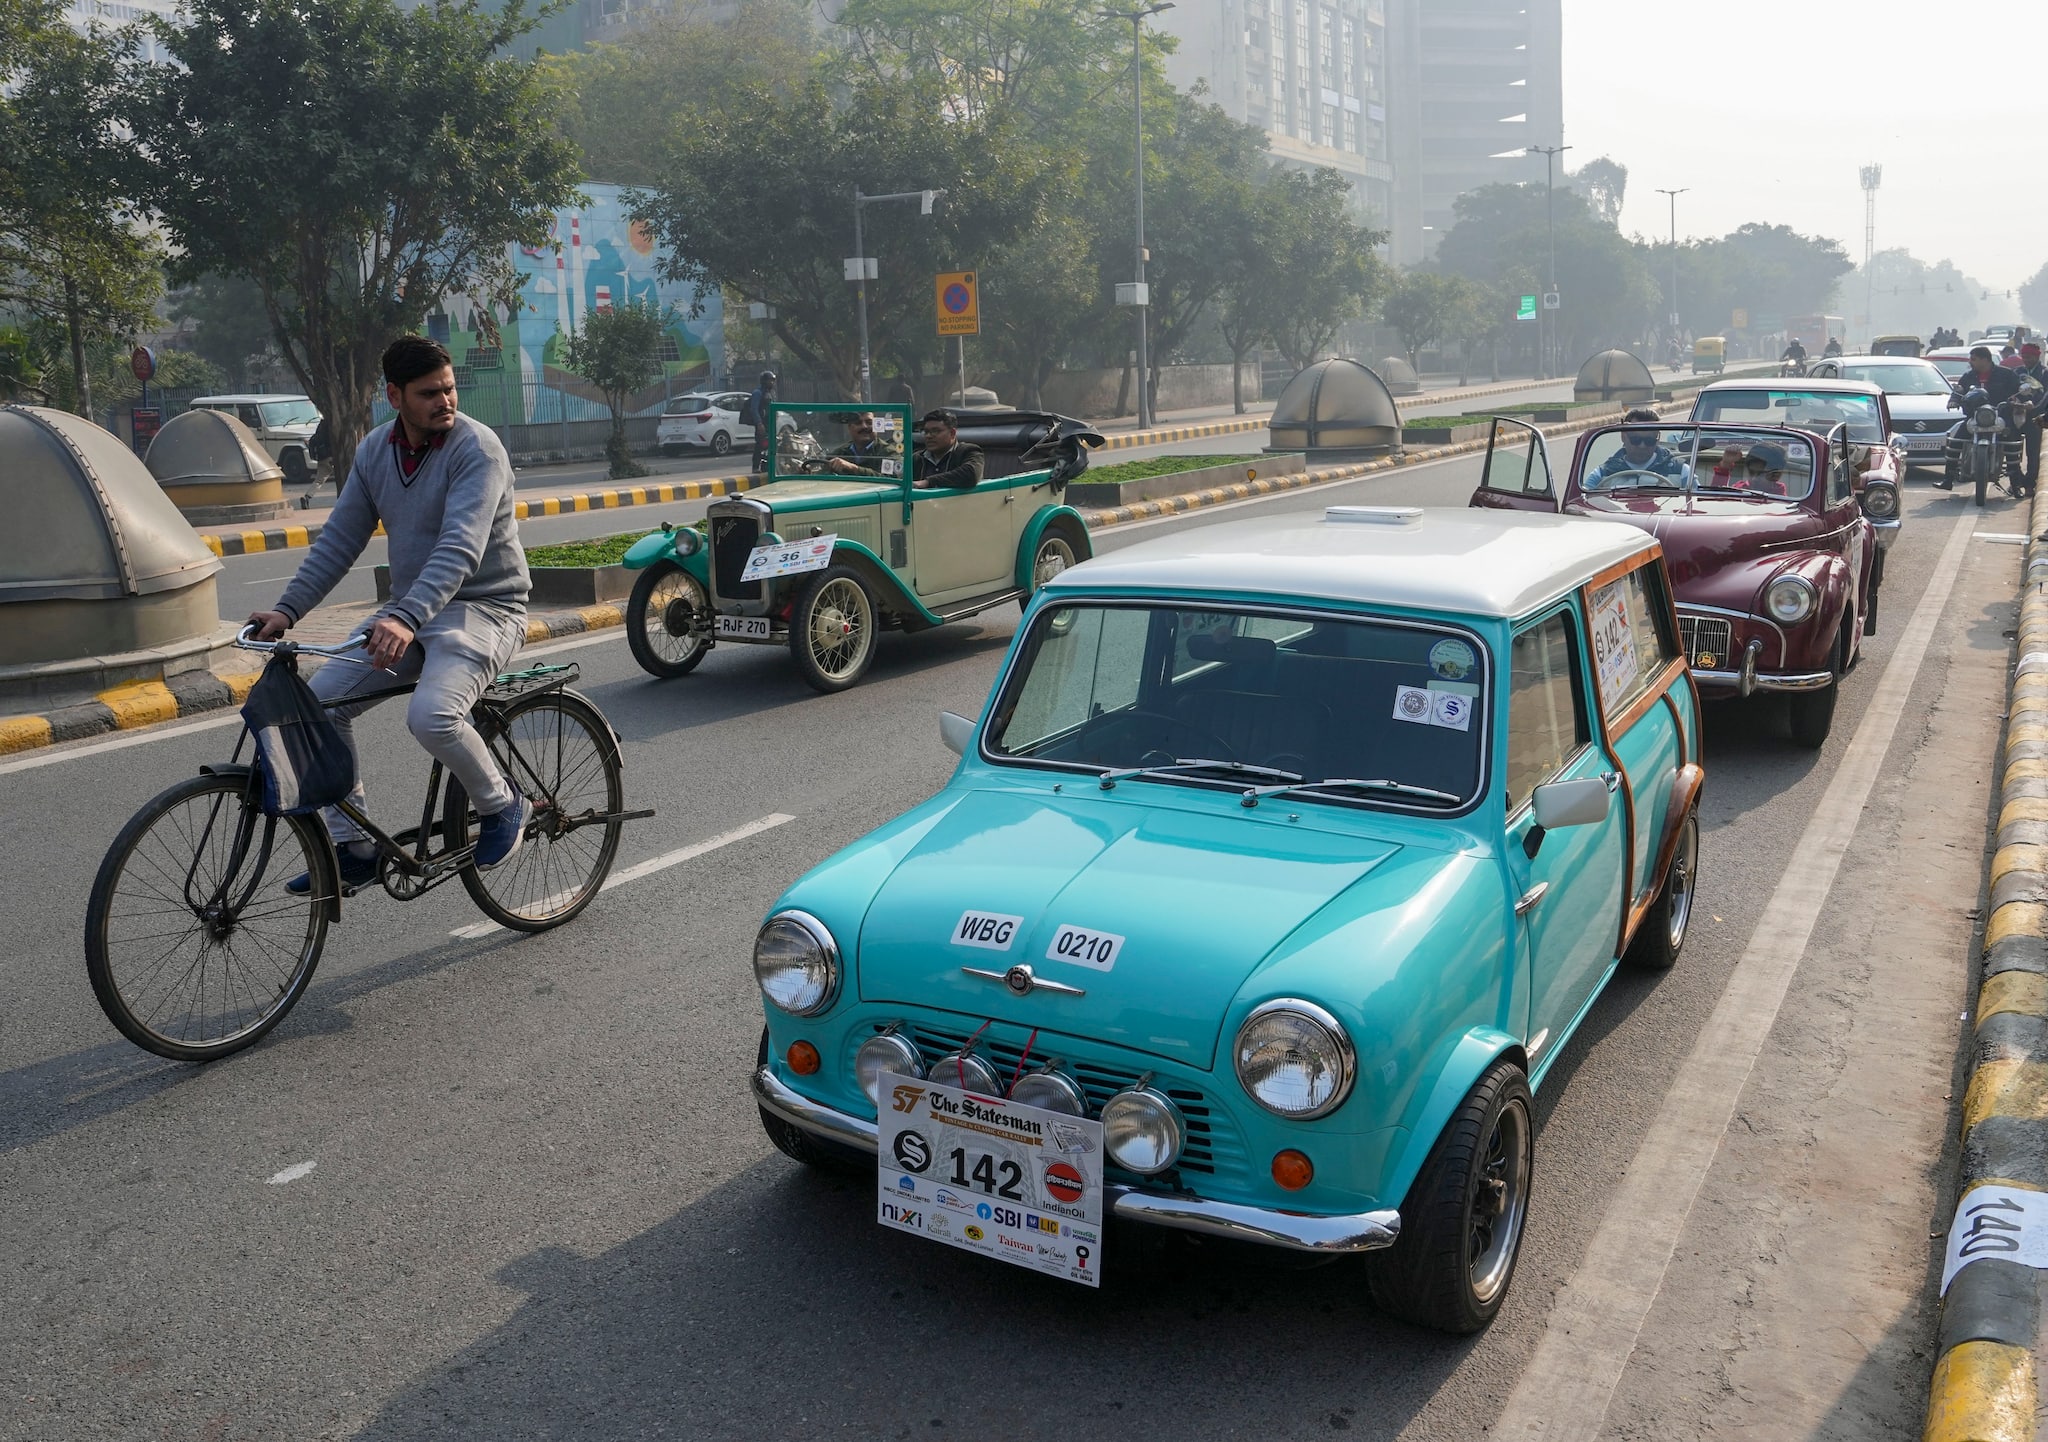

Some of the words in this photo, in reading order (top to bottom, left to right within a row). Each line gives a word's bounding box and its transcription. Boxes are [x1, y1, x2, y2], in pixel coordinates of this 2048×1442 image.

[948, 315, 976, 323] STOPPING
[949, 323, 975, 331] PARKING
[779, 551, 800, 563] 36
[723, 618, 743, 632] RJF
[747, 620, 767, 634] 270
[1605, 617, 1620, 655] 142
[1444, 700, 1459, 716] S
[960, 916, 1014, 944] WBG
[1057, 931, 1113, 964] 0210
[929, 1091, 959, 1114] The
[961, 1099, 1043, 1135] Statesman
[944, 1117, 968, 1129] VINTAGE
[974, 1124, 997, 1135] CLASSIC
[997, 1130, 1009, 1138] CAR
[1009, 1133, 1028, 1143] RALLY
[951, 1147, 1022, 1201] 142
[912, 1194, 931, 1204] LIMITED
[994, 1206, 1021, 1229] SBI
[1043, 1201, 1085, 1219] IndianOil
[927, 1223, 951, 1238] Kairali
[1040, 1218, 1057, 1233] LIC
[1959, 1197, 2025, 1258] 140
[977, 1243, 994, 1252] Limited
[998, 1233, 1034, 1253] Taiwan
[1079, 1273, 1093, 1282] INDIA
